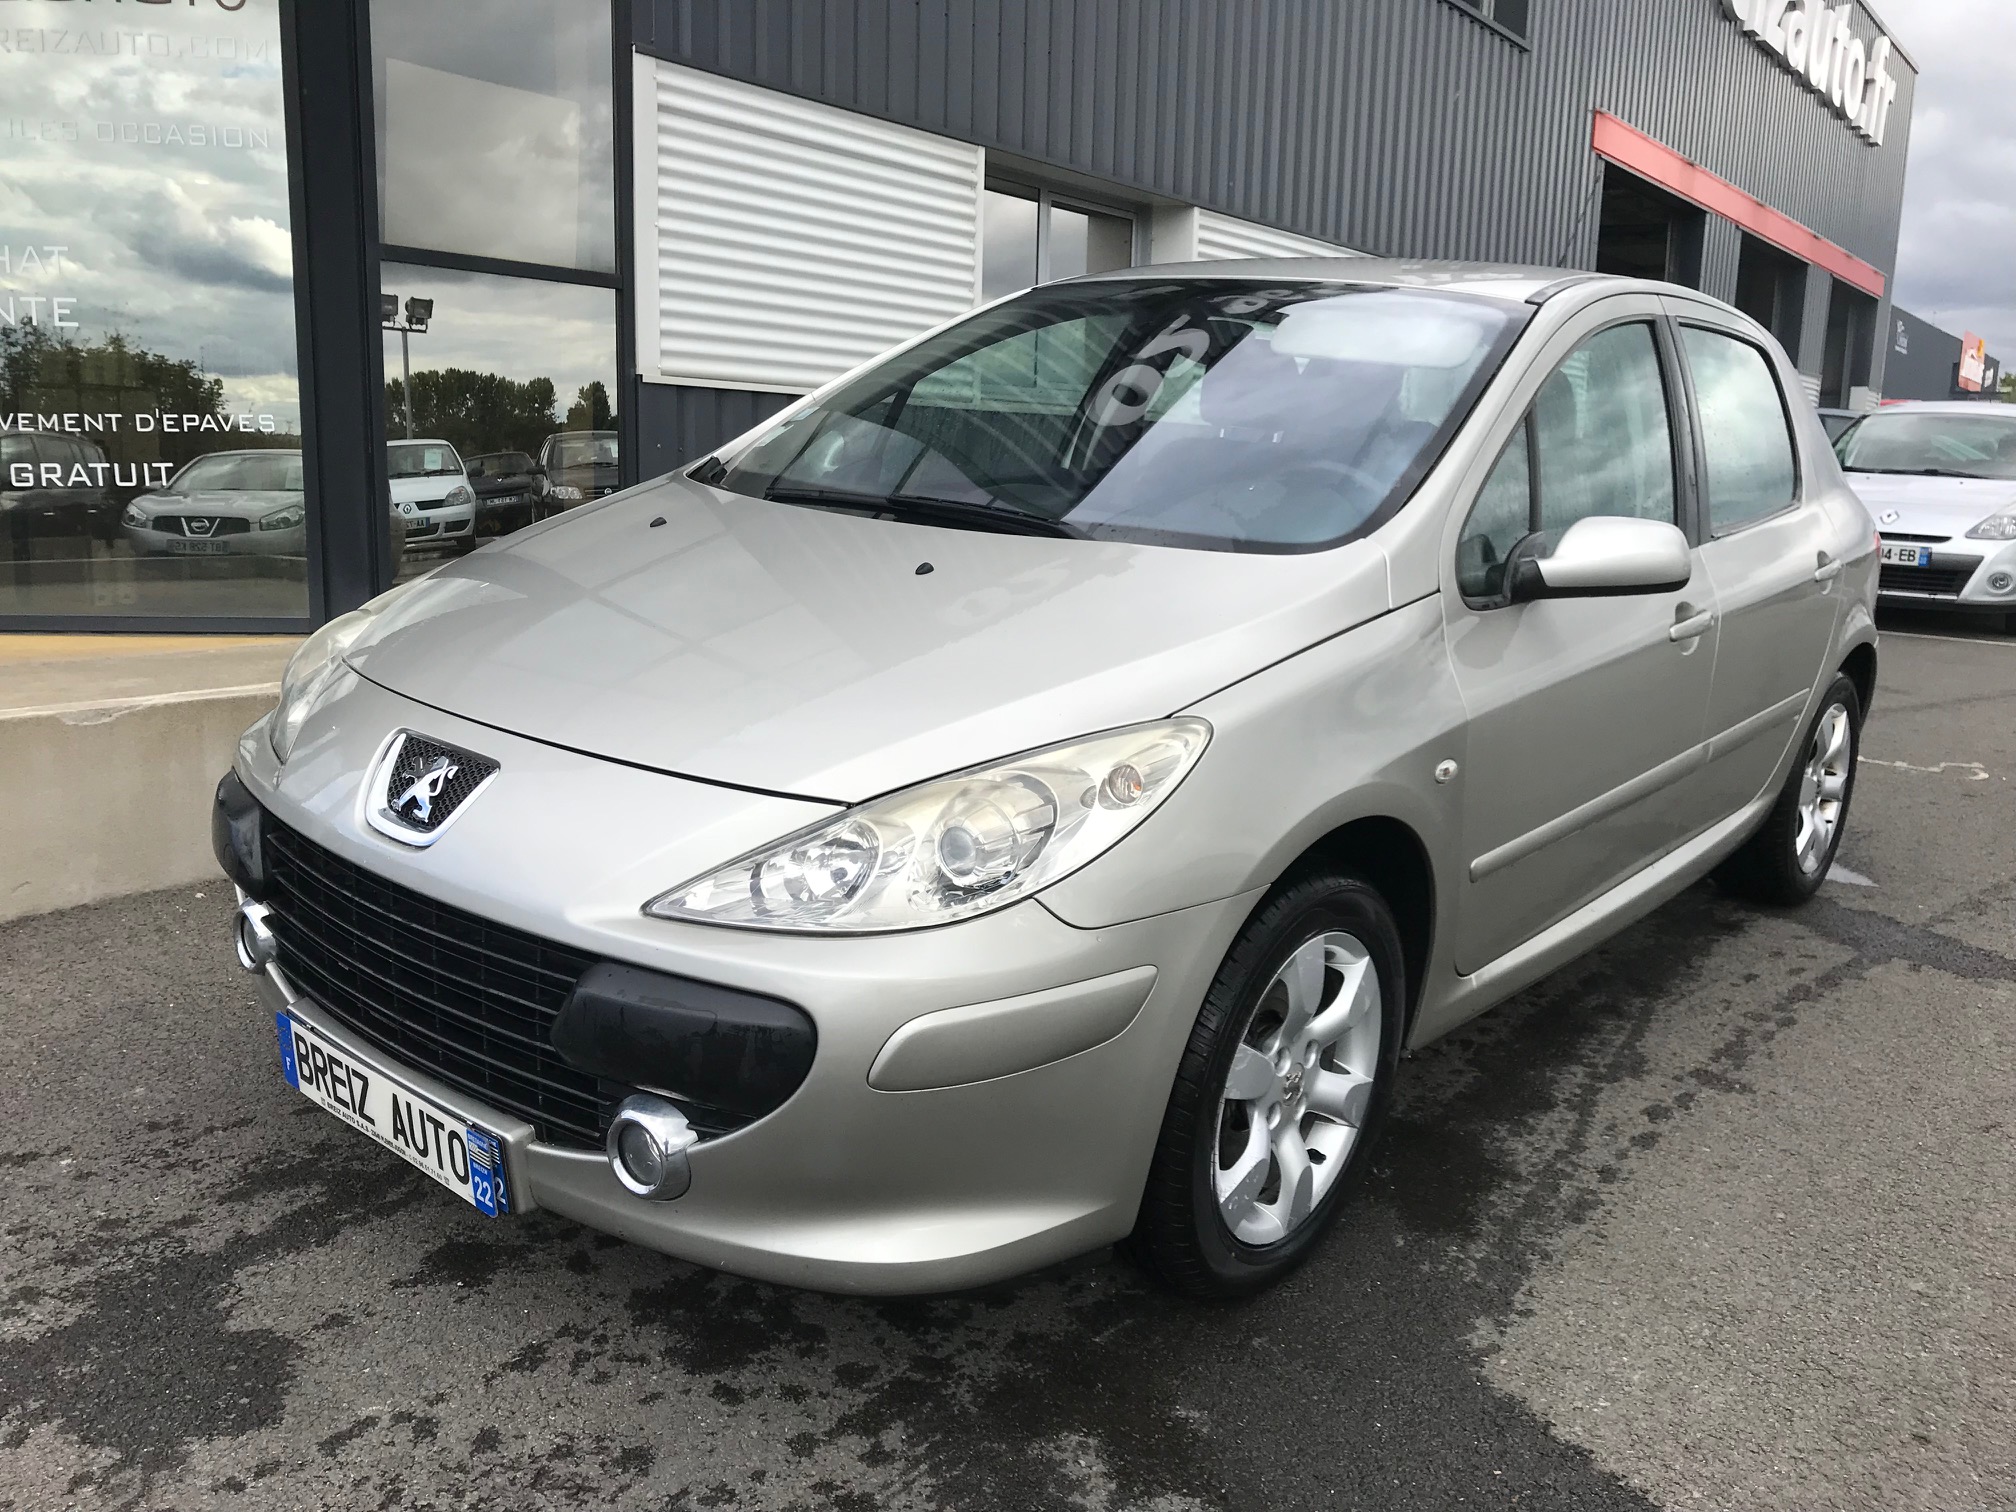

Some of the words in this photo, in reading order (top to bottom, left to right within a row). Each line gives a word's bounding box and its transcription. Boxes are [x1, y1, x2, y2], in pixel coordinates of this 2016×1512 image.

[1723, 0, 1897, 147] zauto.fr
[96, 121, 269, 148] OCCASION
[0, 412, 122, 432] VEMENT
[135, 407, 276, 432] D'EPAVES
[10, 462, 174, 488] GRATUIT
[285, 1056, 291, 1071] F
[294, 1030, 376, 1127] BREIZ
[392, 1092, 471, 1187] AUTO
[474, 1175, 493, 1208] 22
